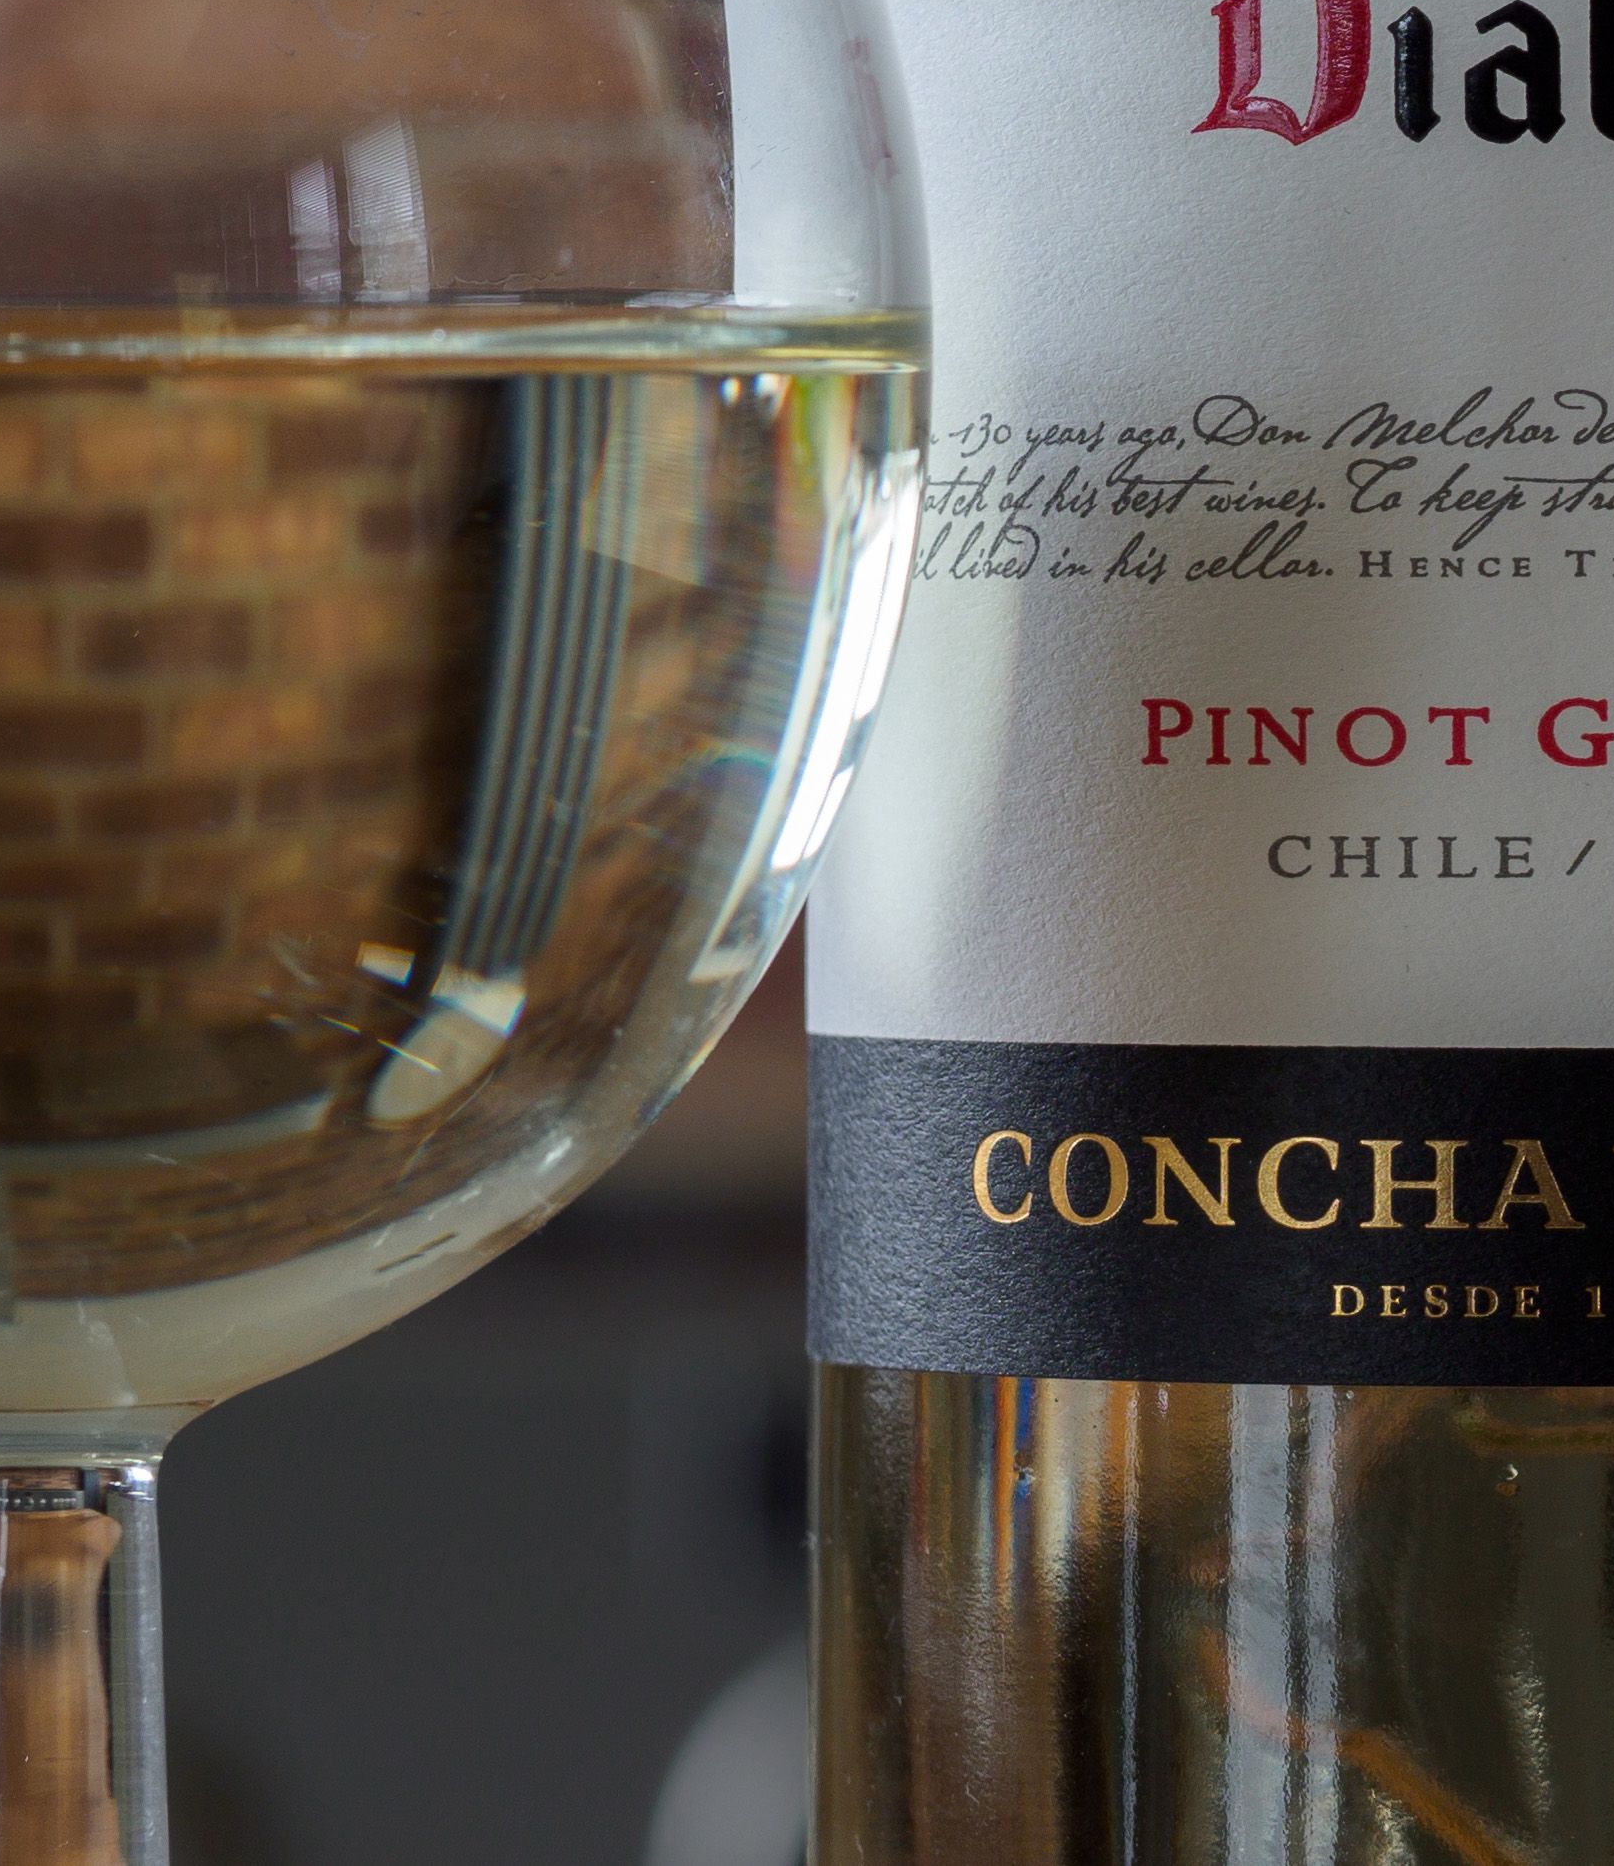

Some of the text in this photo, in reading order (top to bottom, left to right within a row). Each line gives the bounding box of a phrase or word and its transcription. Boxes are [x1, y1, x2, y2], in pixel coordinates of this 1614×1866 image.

[1007, 420, 1106, 485] years
[1106, 425, 1186, 487] ago,
[1192, 394, 1312, 447] Don
[1321, 385, 1560, 450] Melchor
[921, 465, 997, 518] atch
[1041, 465, 1099, 519] his
[1111, 464, 1235, 520] best
[1204, 480, 1326, 518] wines.
[1345, 455, 1418, 514] To
[1417, 462, 1527, 552] keep
[948, 520, 1041, 581] lived
[1048, 547, 1093, 580] in
[1102, 530, 1168, 585] his
[1185, 519, 1335, 582] cellar.
[1140, 697, 1492, 767] PINOT
[971, 1128, 1586, 1232] CONCHA
[1329, 1283, 1542, 1319] DESDE
